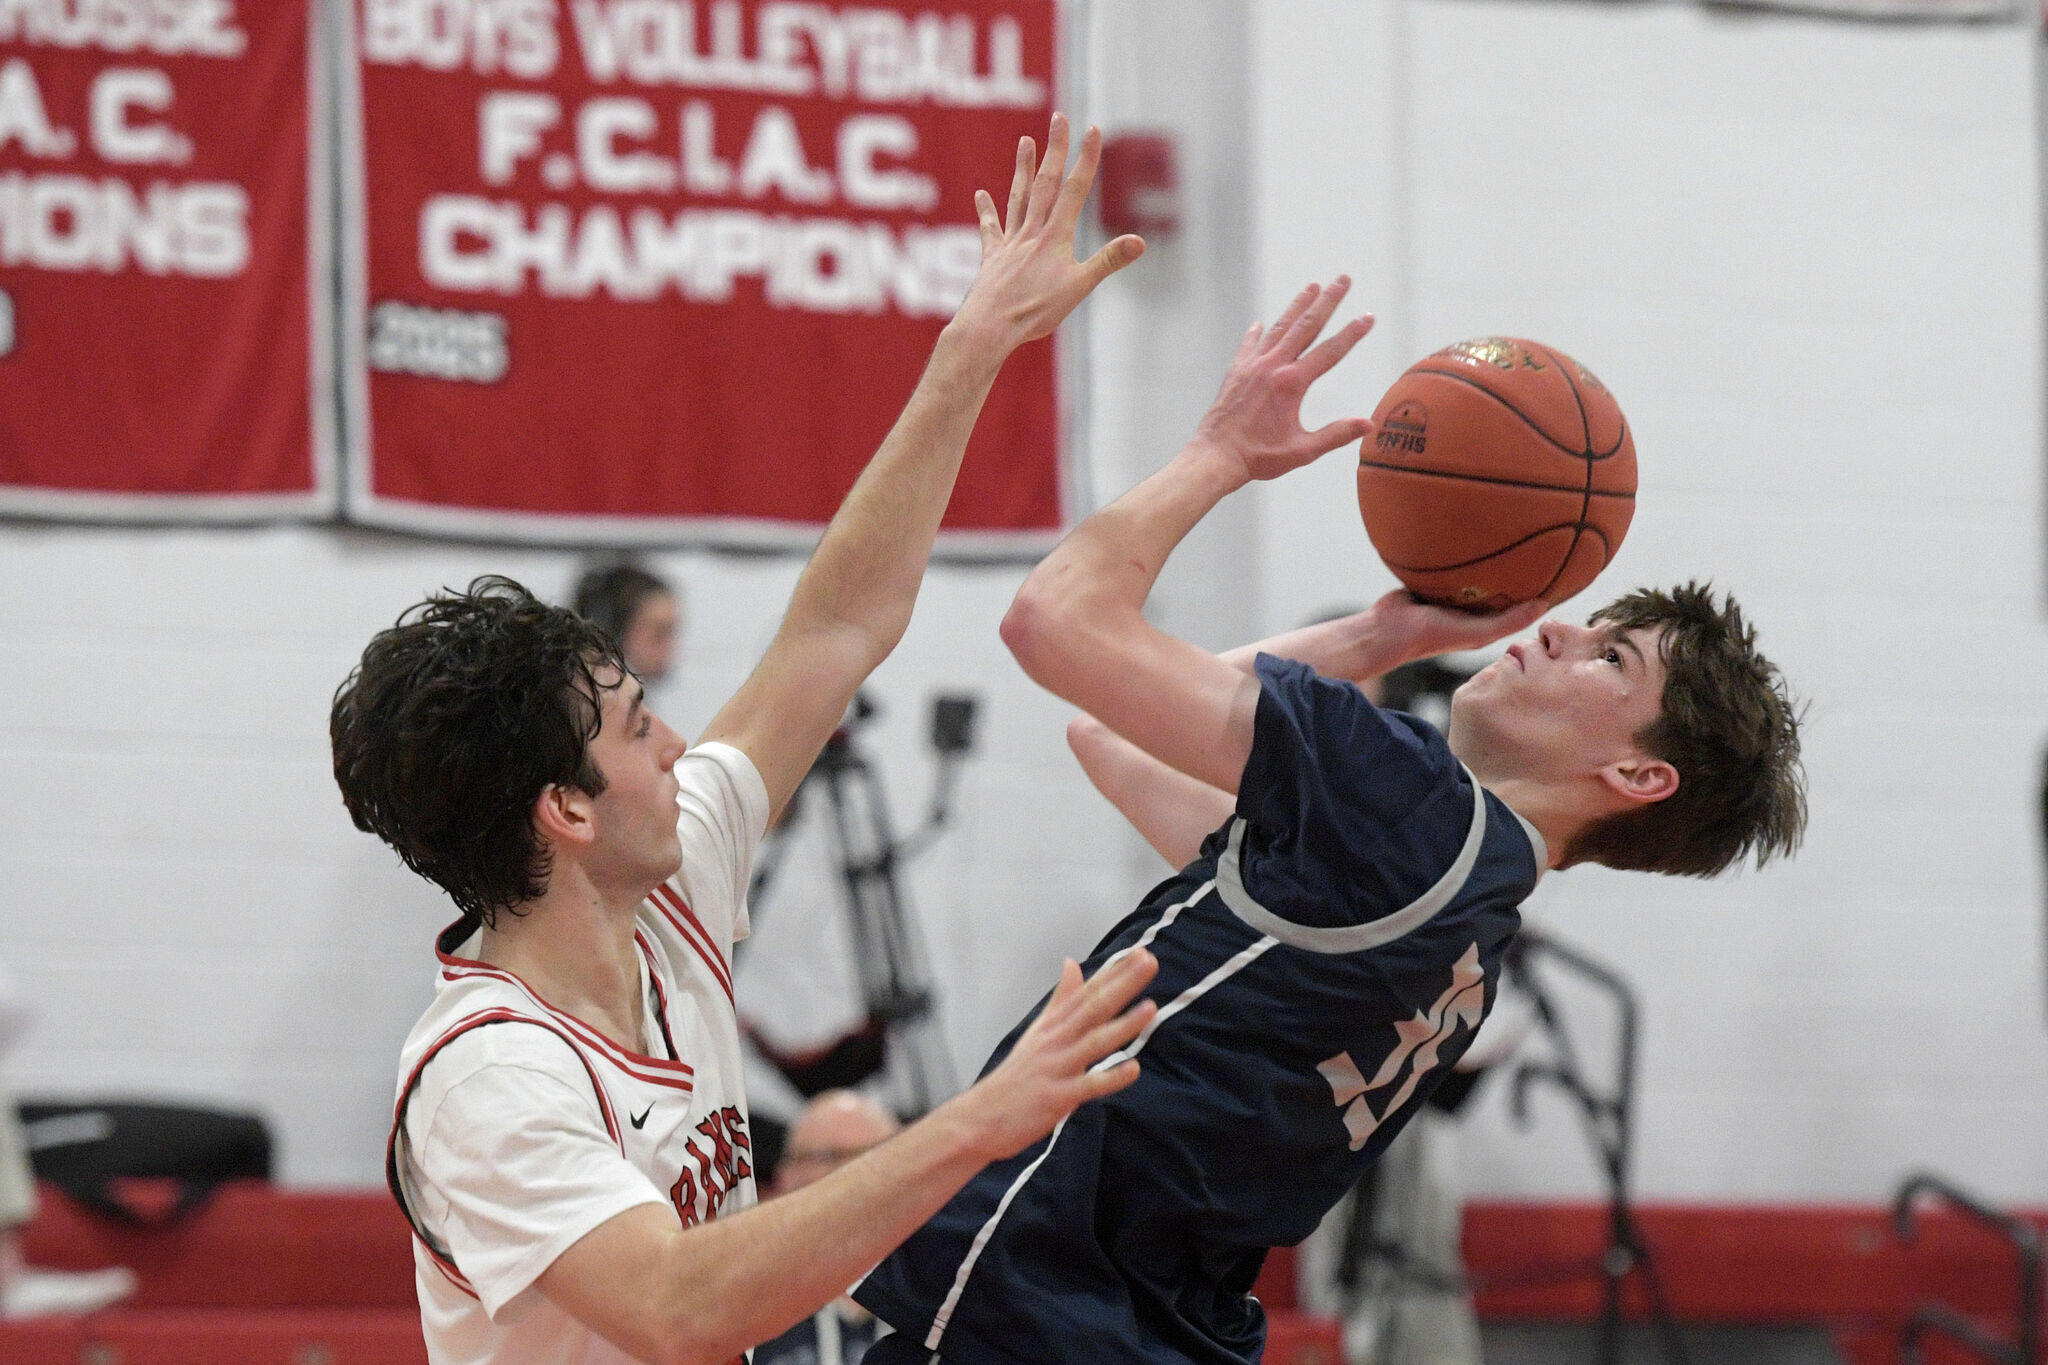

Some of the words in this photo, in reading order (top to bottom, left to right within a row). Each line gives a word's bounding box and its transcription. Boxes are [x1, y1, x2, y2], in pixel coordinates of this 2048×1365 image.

[362, 0, 561, 79] BOYS
[567, 0, 1046, 109] VOLLEYBALL
[478, 92, 941, 212] F.C.I.A.C.
[418, 194, 982, 319] CHAMPIONS
[669, 1104, 752, 1231] RAMS
